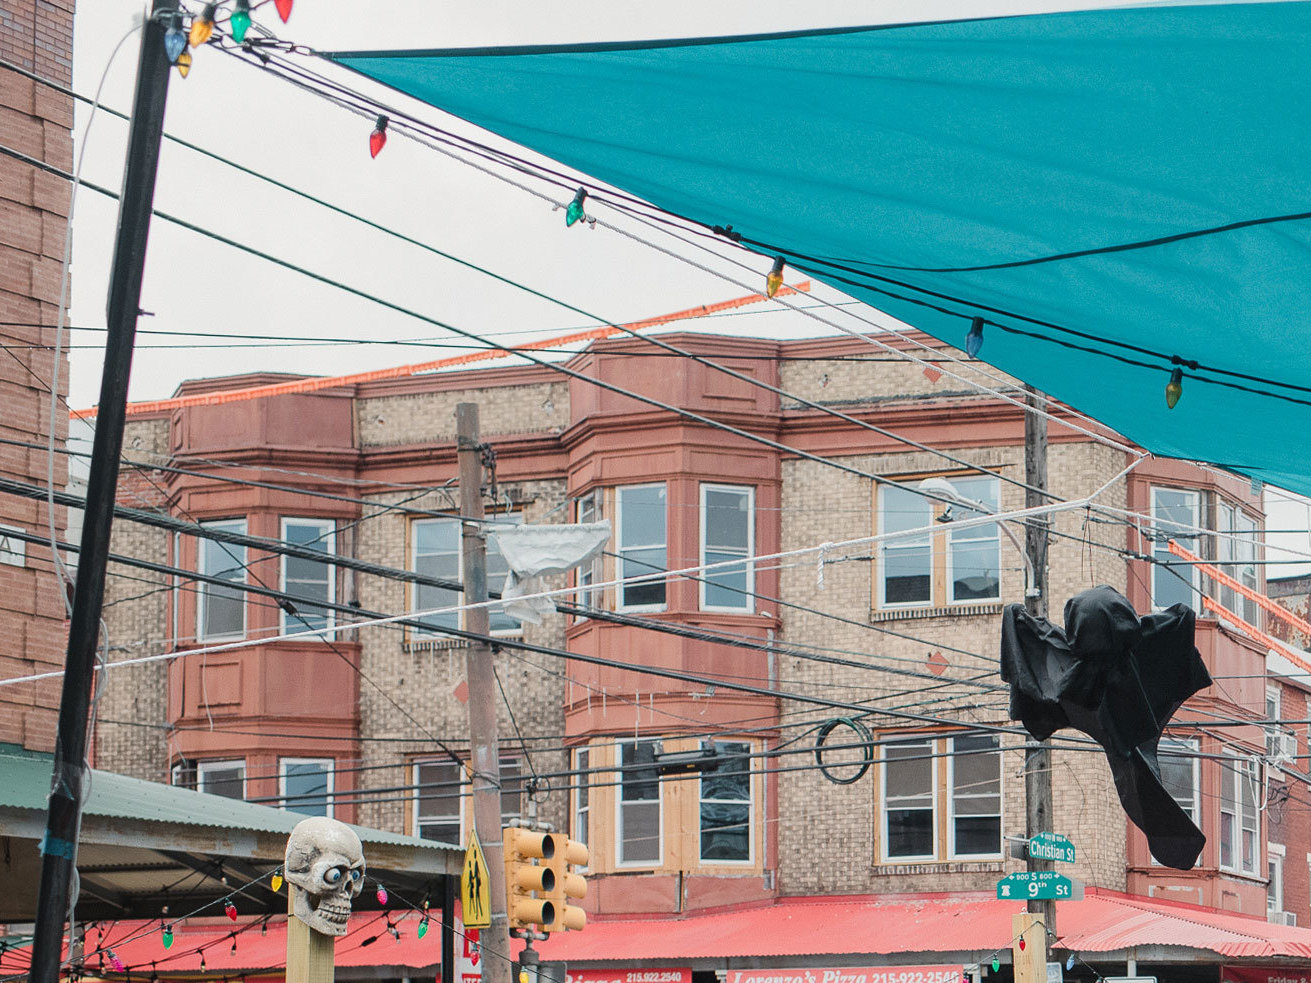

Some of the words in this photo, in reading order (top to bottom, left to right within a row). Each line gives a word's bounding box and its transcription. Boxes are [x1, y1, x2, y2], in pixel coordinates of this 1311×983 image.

[1030, 840, 1065, 860] Christian
[1066, 847, 1074, 862] St
[1031, 872, 1038, 881] S
[1028, 881, 1048, 897] 9th
[1056, 884, 1069, 895] St
